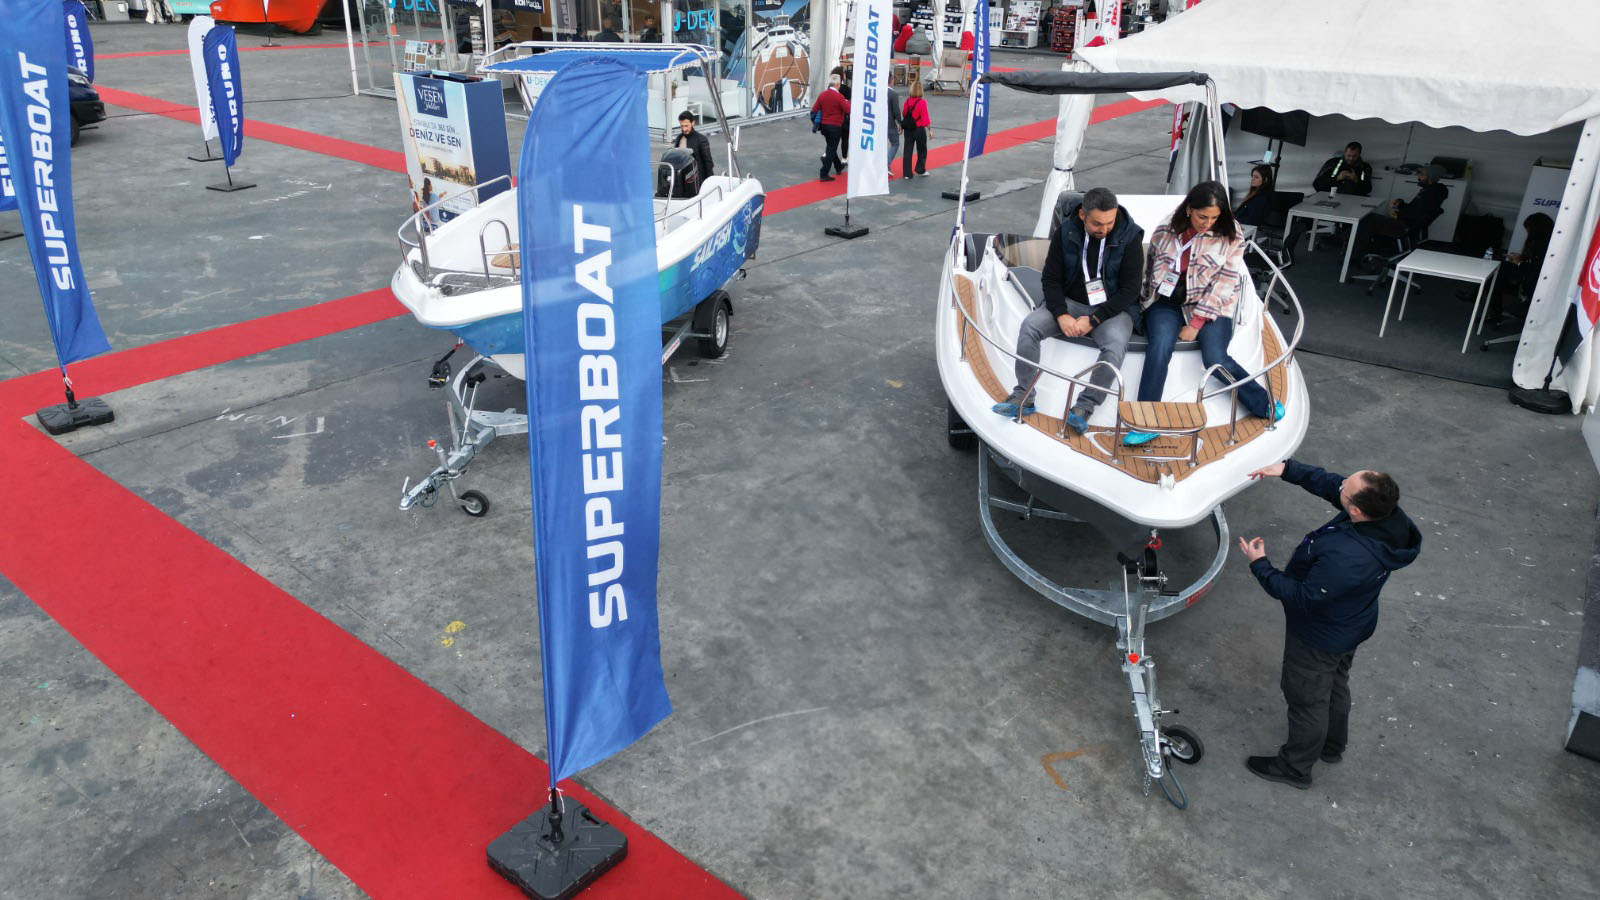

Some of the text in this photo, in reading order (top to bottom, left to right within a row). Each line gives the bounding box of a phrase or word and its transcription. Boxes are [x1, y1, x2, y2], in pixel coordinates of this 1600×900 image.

[418, 88, 443, 104] VESEN
[434, 133, 446, 145] VE
[446, 136, 461, 149] SEN
[860, 4, 879, 151] SUPERBOAT
[18, 51, 75, 290] SUPERBOAT
[573, 203, 629, 630] SUPERBOAT
